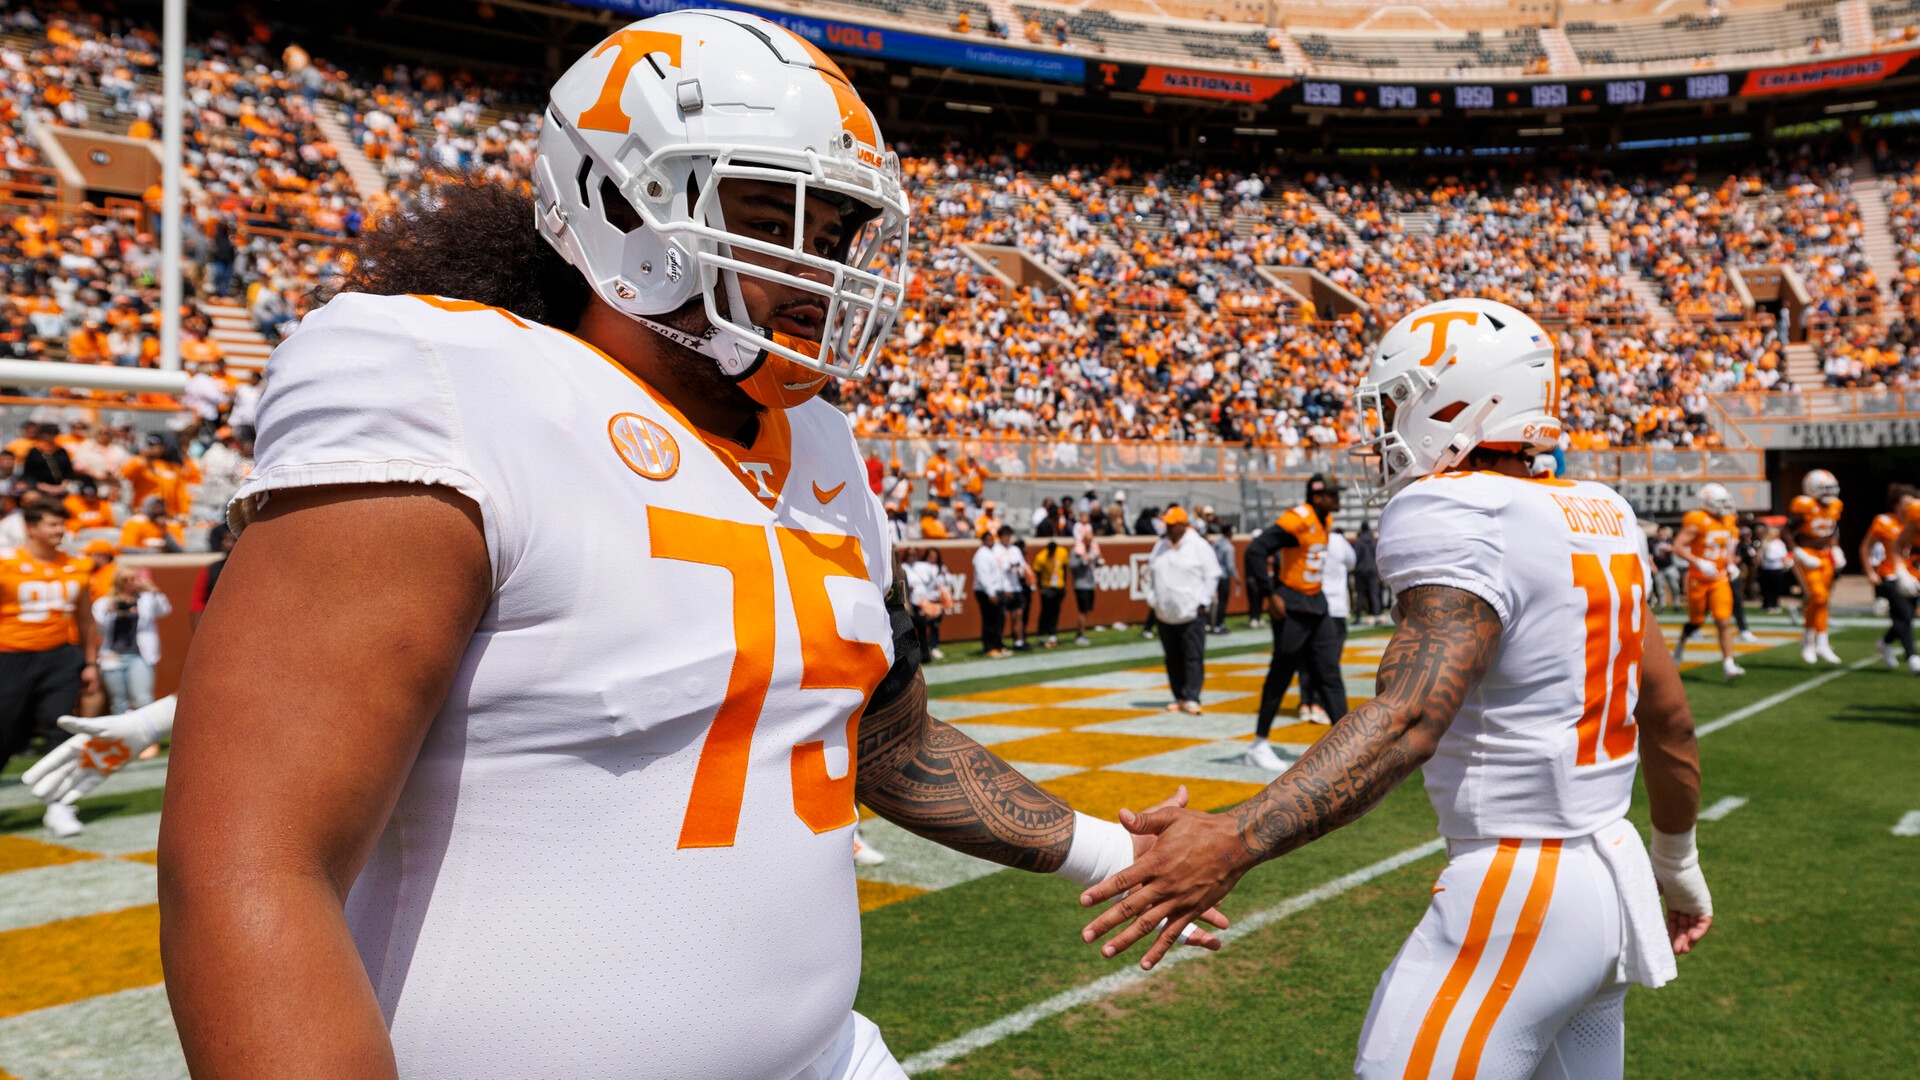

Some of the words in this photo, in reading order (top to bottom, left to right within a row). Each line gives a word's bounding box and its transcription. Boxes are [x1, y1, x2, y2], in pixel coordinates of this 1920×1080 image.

[826, 24, 883, 51] VOLS
[577, 30, 682, 134] T
[1100, 64, 1119, 85] T
[1163, 73, 1253, 94] NATIONAL
[1378, 86, 1417, 108] 1940
[1455, 86, 1494, 109] 1950
[1531, 84, 1567, 107] 1951
[1606, 80, 1646, 105] 1967
[1686, 74, 1729, 99] 1998
[1758, 60, 1885, 88] CHAMPIONS
[857, 147, 883, 168] VOLS
[1410, 311, 1479, 367] T
[613, 416, 674, 474] SEC
[738, 462, 776, 498] T
[1550, 493, 1624, 537] BISHOP
[646, 504, 890, 848] 75
[1571, 553, 1645, 767] 18
